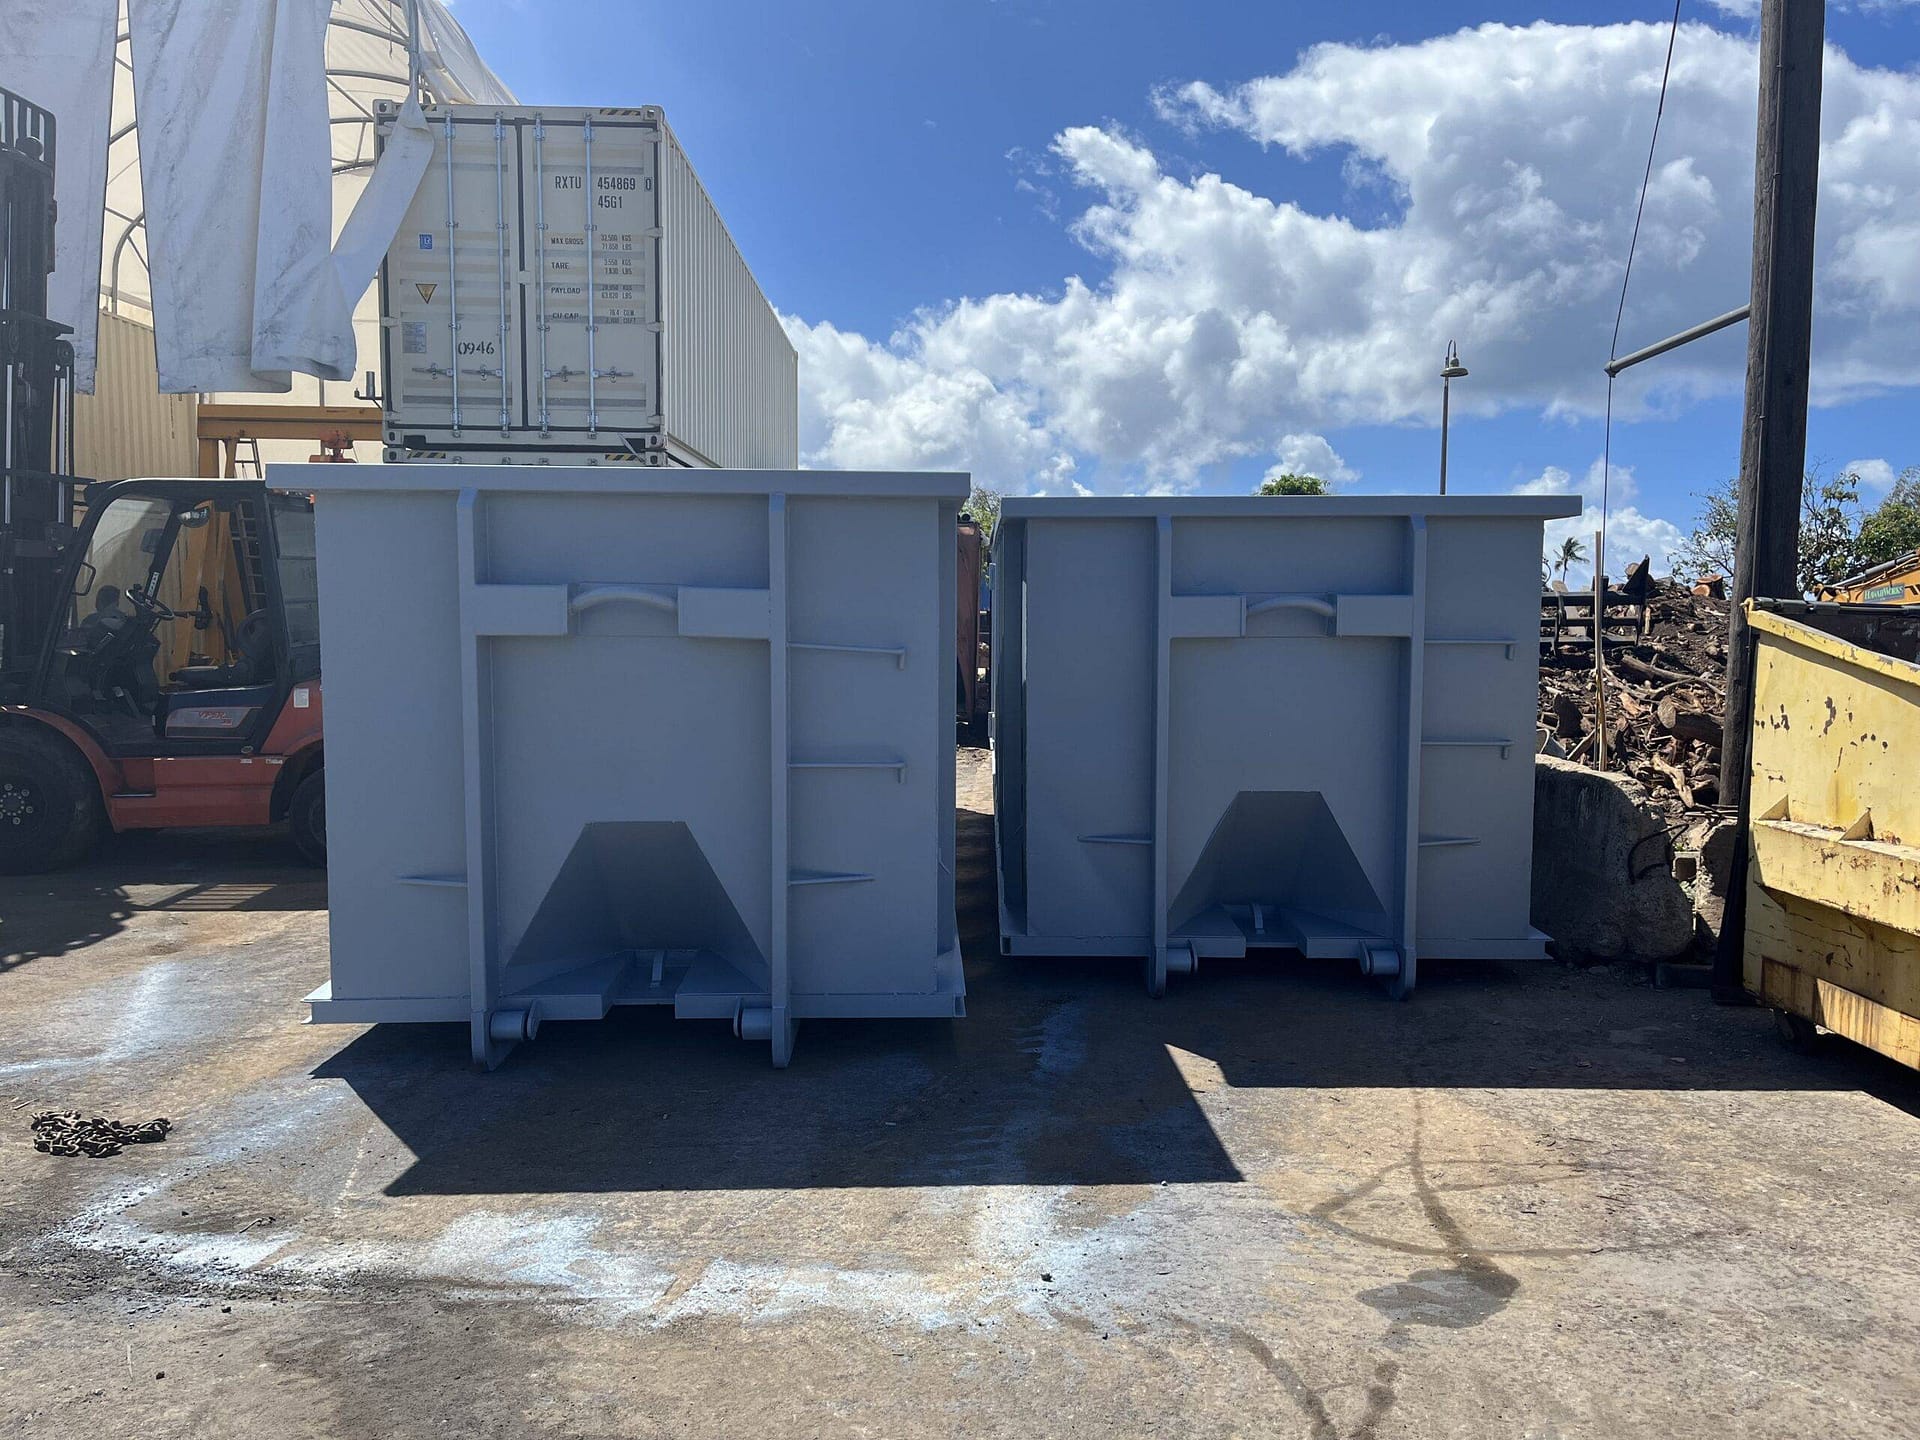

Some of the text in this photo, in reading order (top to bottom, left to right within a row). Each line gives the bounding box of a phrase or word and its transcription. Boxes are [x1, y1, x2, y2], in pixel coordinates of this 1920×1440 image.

[555, 175, 652, 191] RXTU 454869 0
[598, 195, 622, 209] 45G1
[551, 261, 570, 270] TARE
[550, 286, 581, 295] PAYLOAD
[457, 340, 495, 355] 0946
